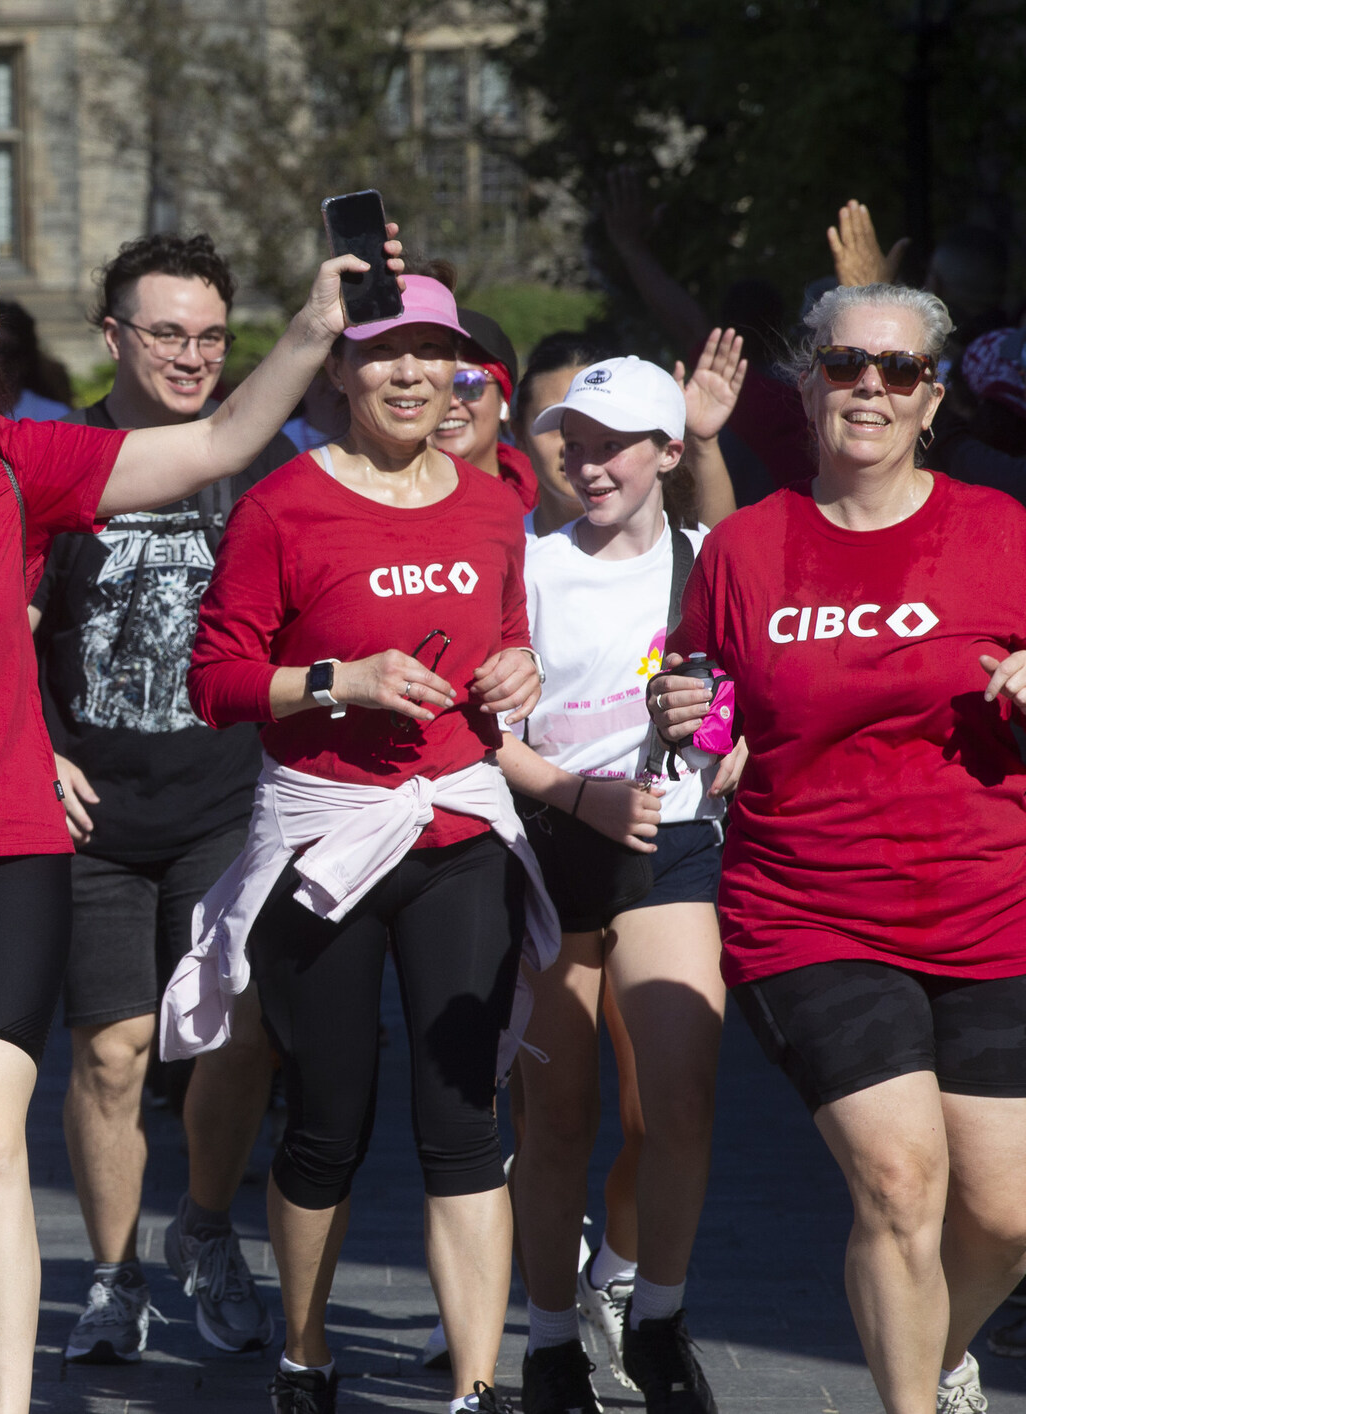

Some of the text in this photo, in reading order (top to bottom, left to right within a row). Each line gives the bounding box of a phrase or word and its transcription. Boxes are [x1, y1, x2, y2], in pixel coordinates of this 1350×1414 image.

[369, 563, 448, 598] CIBC
[768, 603, 881, 644] CIBC
[607, 770, 627, 778] RUN
